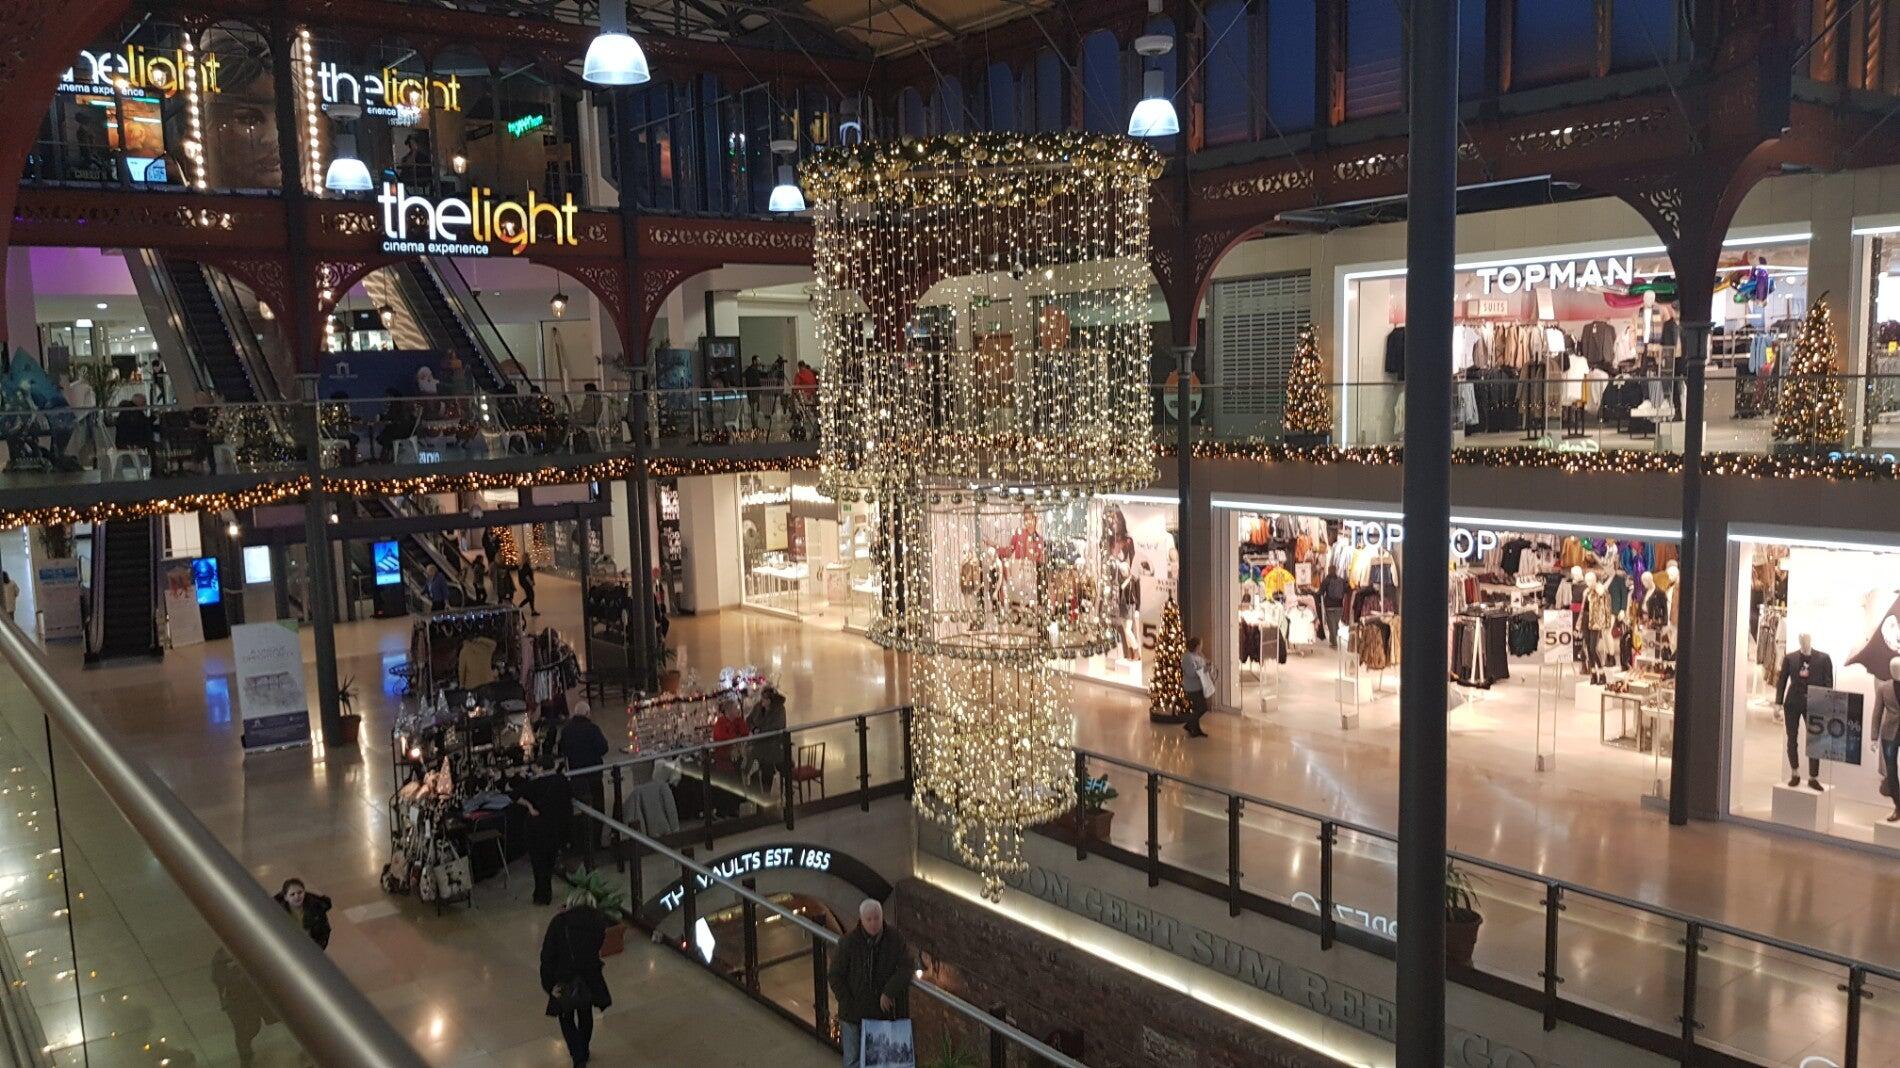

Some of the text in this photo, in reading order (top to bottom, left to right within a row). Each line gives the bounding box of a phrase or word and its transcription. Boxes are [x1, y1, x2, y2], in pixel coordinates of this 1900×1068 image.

[382, 241, 489, 255] cinema experience
[1476, 256, 1634, 295] TOPMAN
[1344, 519, 1498, 560] TOPOP
[659, 884, 697, 912] TH
[764, 847, 795, 867] EST.
[799, 848, 832, 871] 1855
[1192, 927, 1285, 997] SUM
[1297, 966, 1398, 1044] REE
